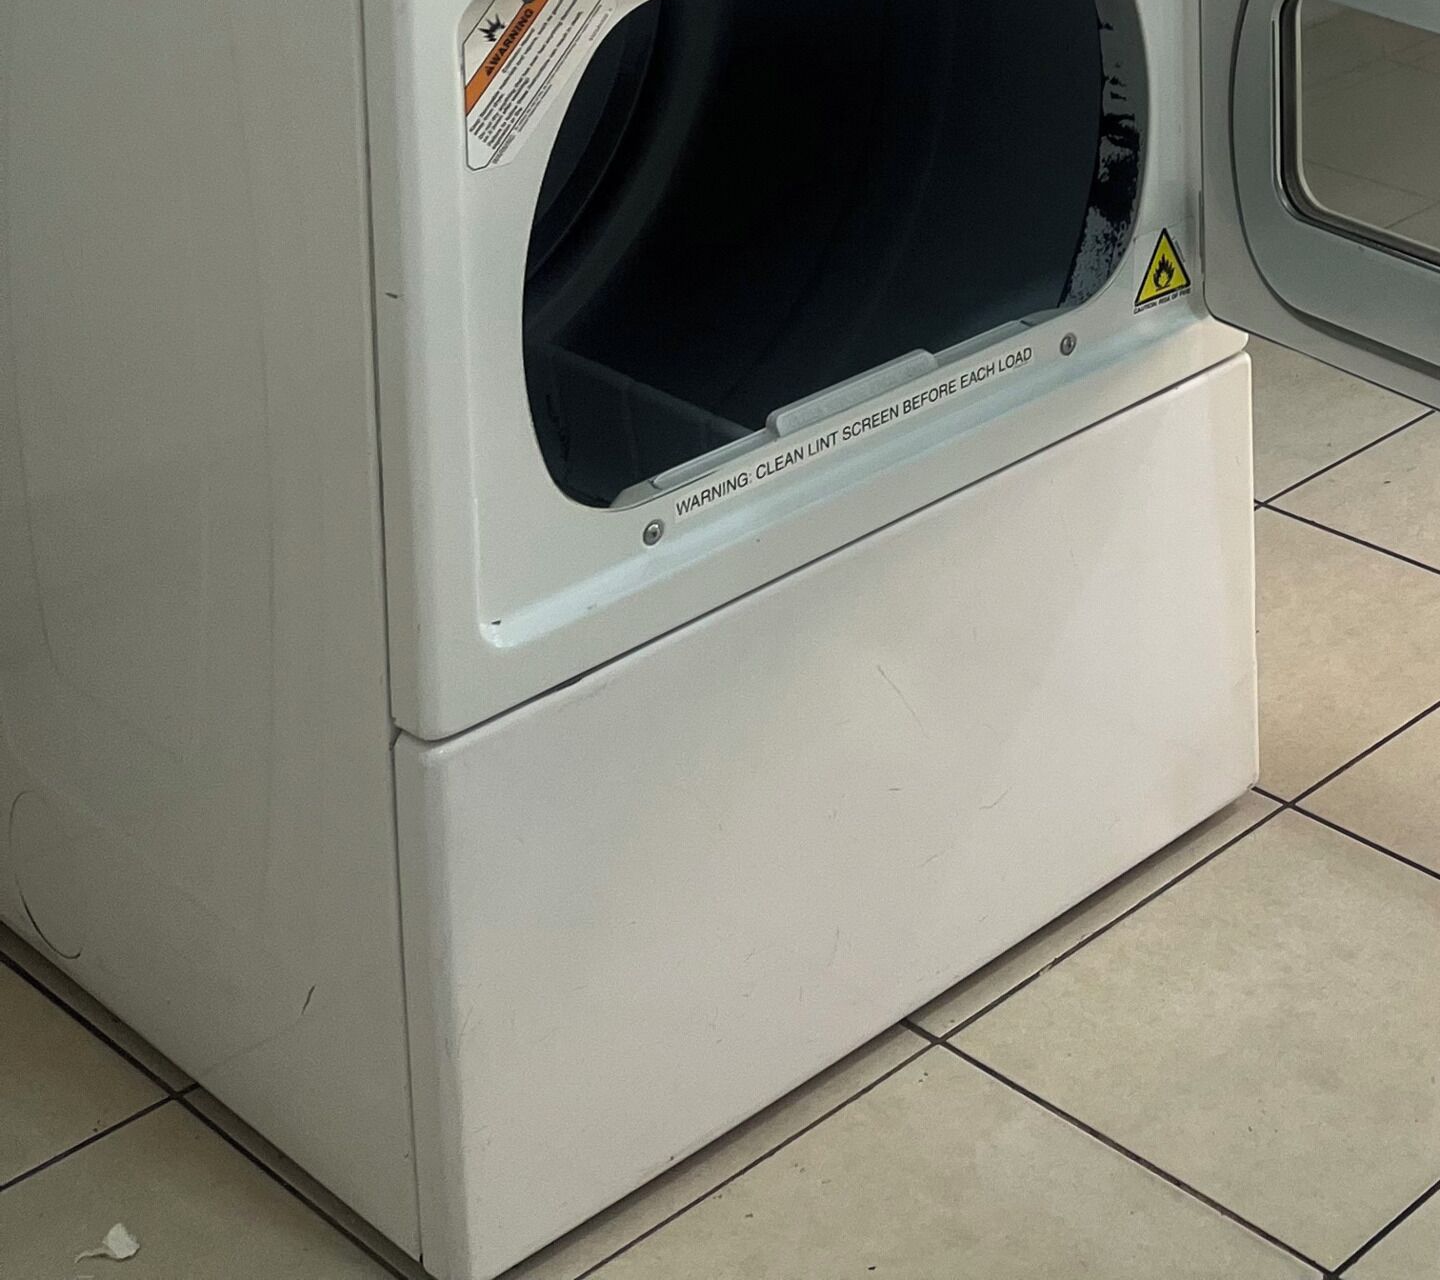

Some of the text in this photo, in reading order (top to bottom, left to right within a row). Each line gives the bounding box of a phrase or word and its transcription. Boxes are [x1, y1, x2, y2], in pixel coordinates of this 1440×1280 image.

[489, 8, 534, 69] WARNING
[675, 347, 1033, 517] WARNING: CLEAN LINT SCREEN BEFORE EACH LOAD
